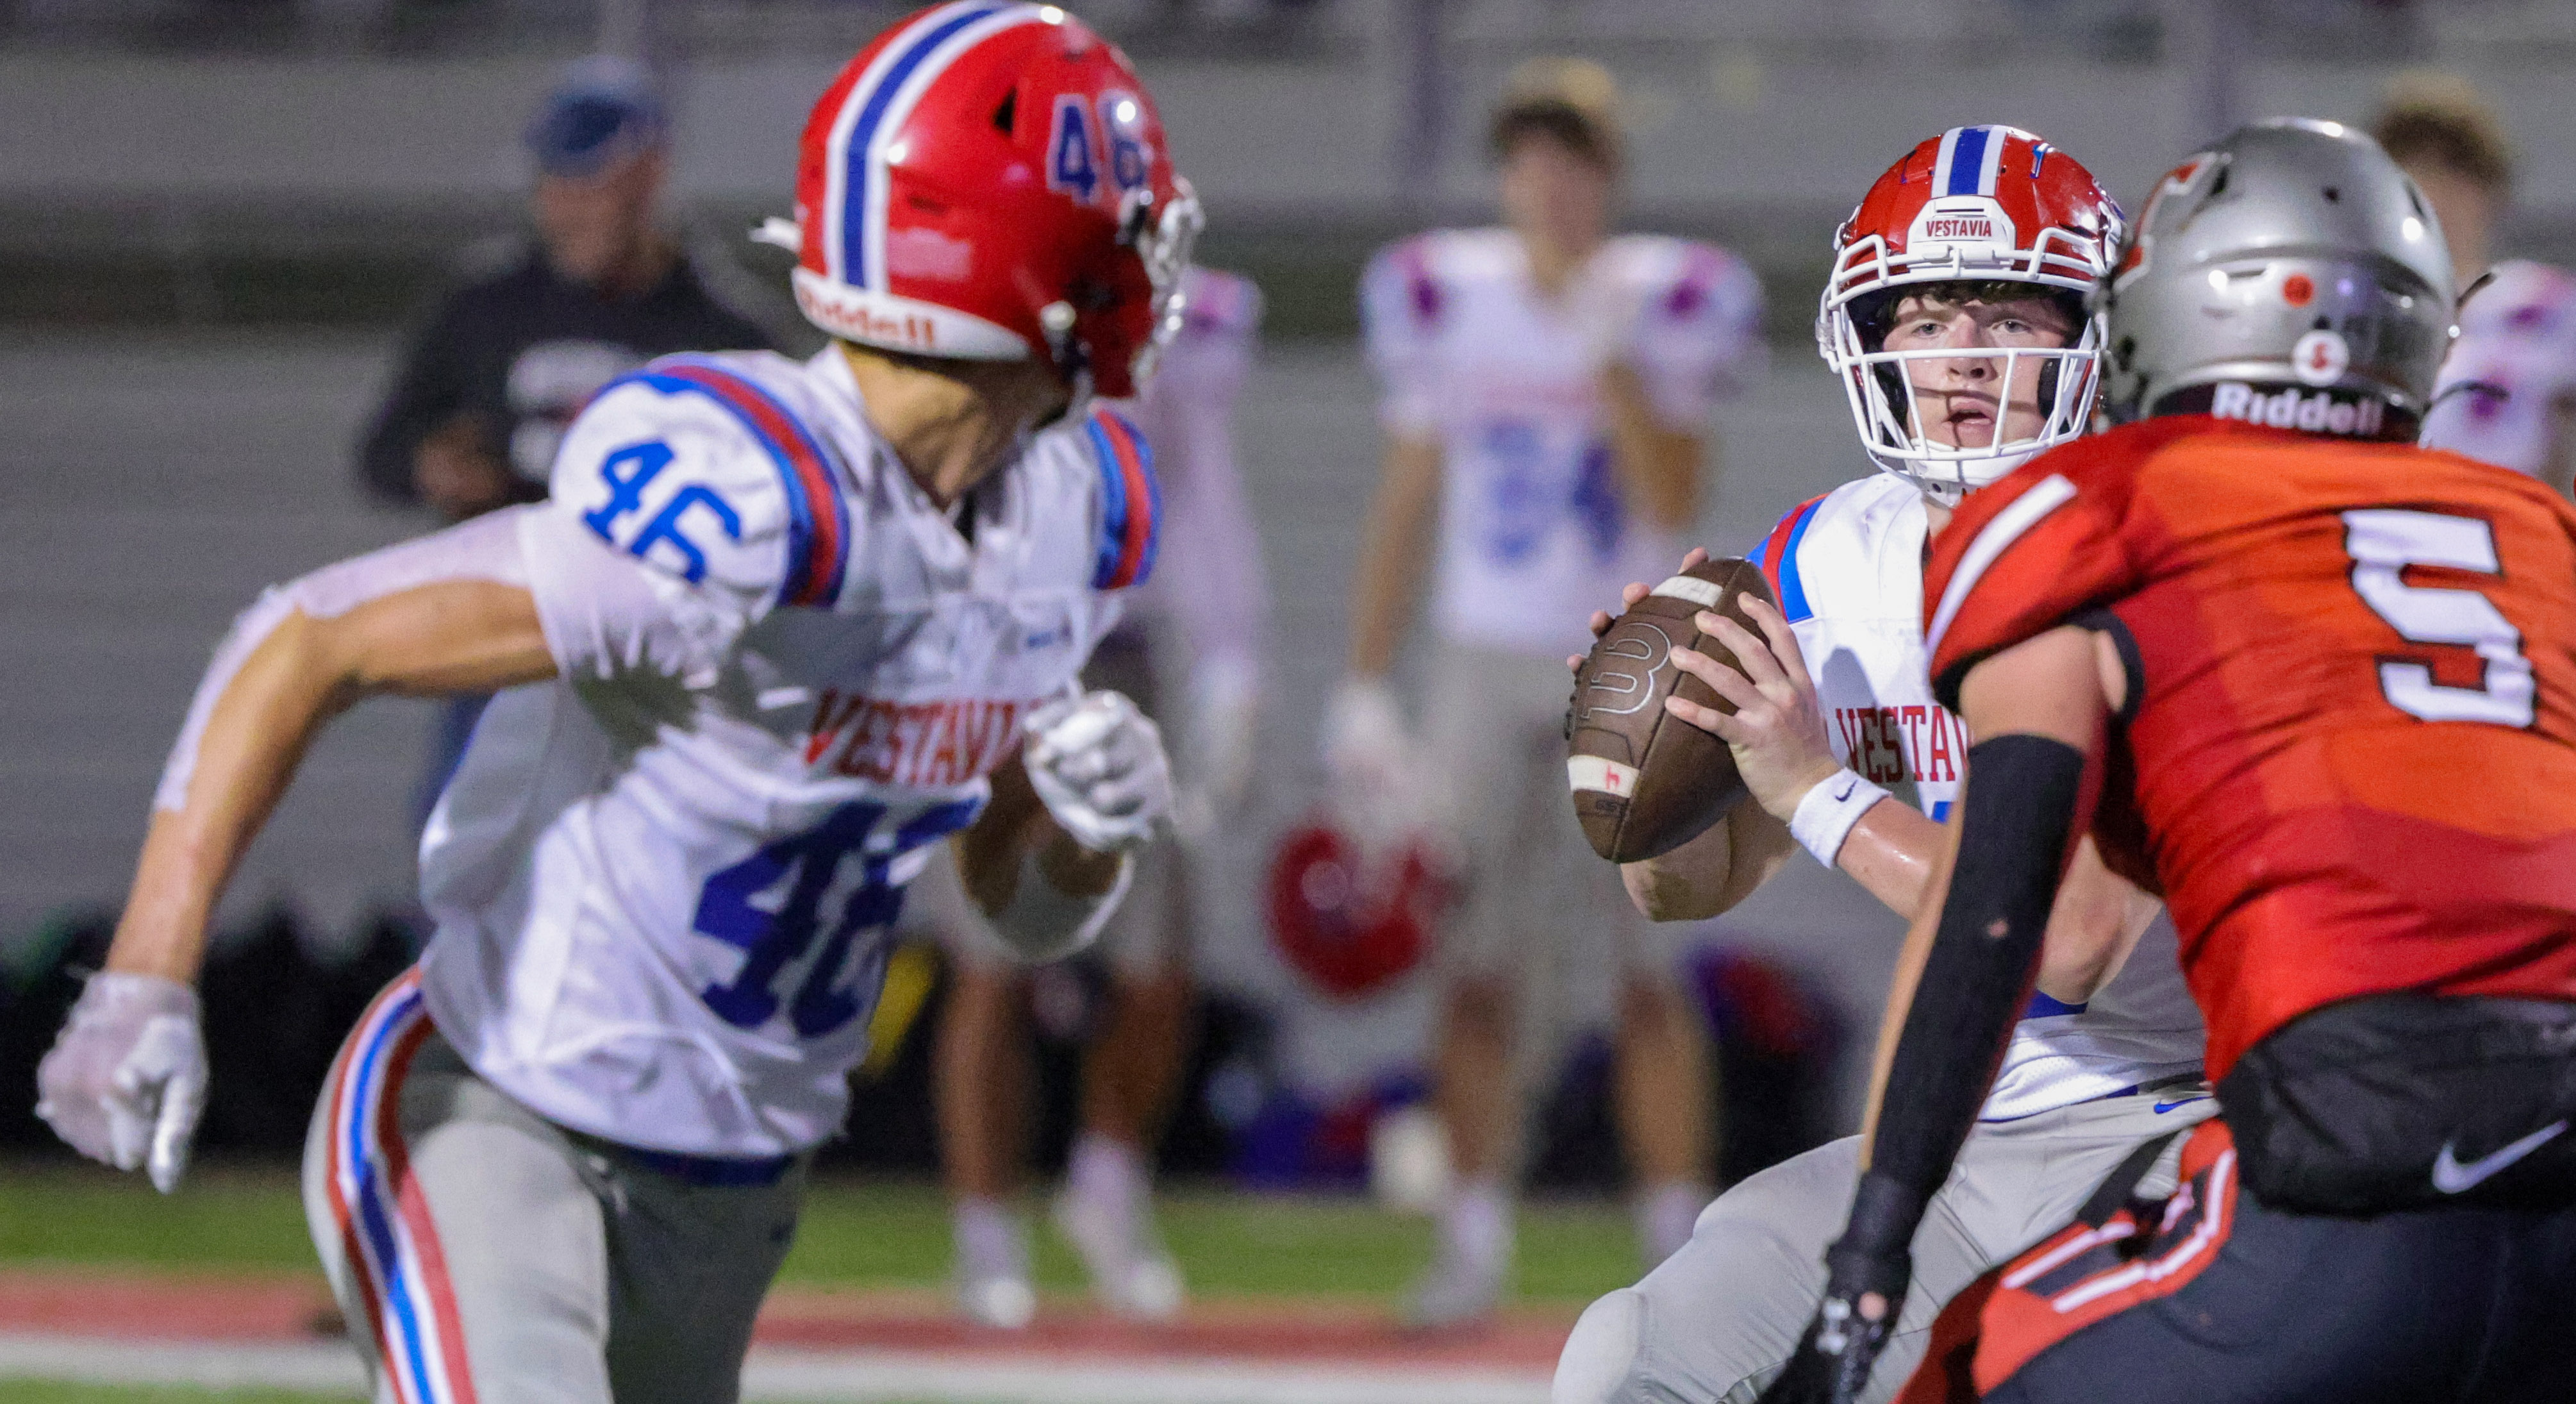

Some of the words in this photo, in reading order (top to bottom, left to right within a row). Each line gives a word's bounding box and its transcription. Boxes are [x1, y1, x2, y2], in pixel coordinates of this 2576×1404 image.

[1048, 93, 1152, 203] 46
[1926, 220, 1992, 238] VESTAVIA
[2212, 383, 2384, 435] Riddell
[583, 441, 741, 584] 46
[2341, 508, 2537, 729] 5
[805, 689, 1040, 786] VESTAVI
[693, 796, 983, 1039] 46
